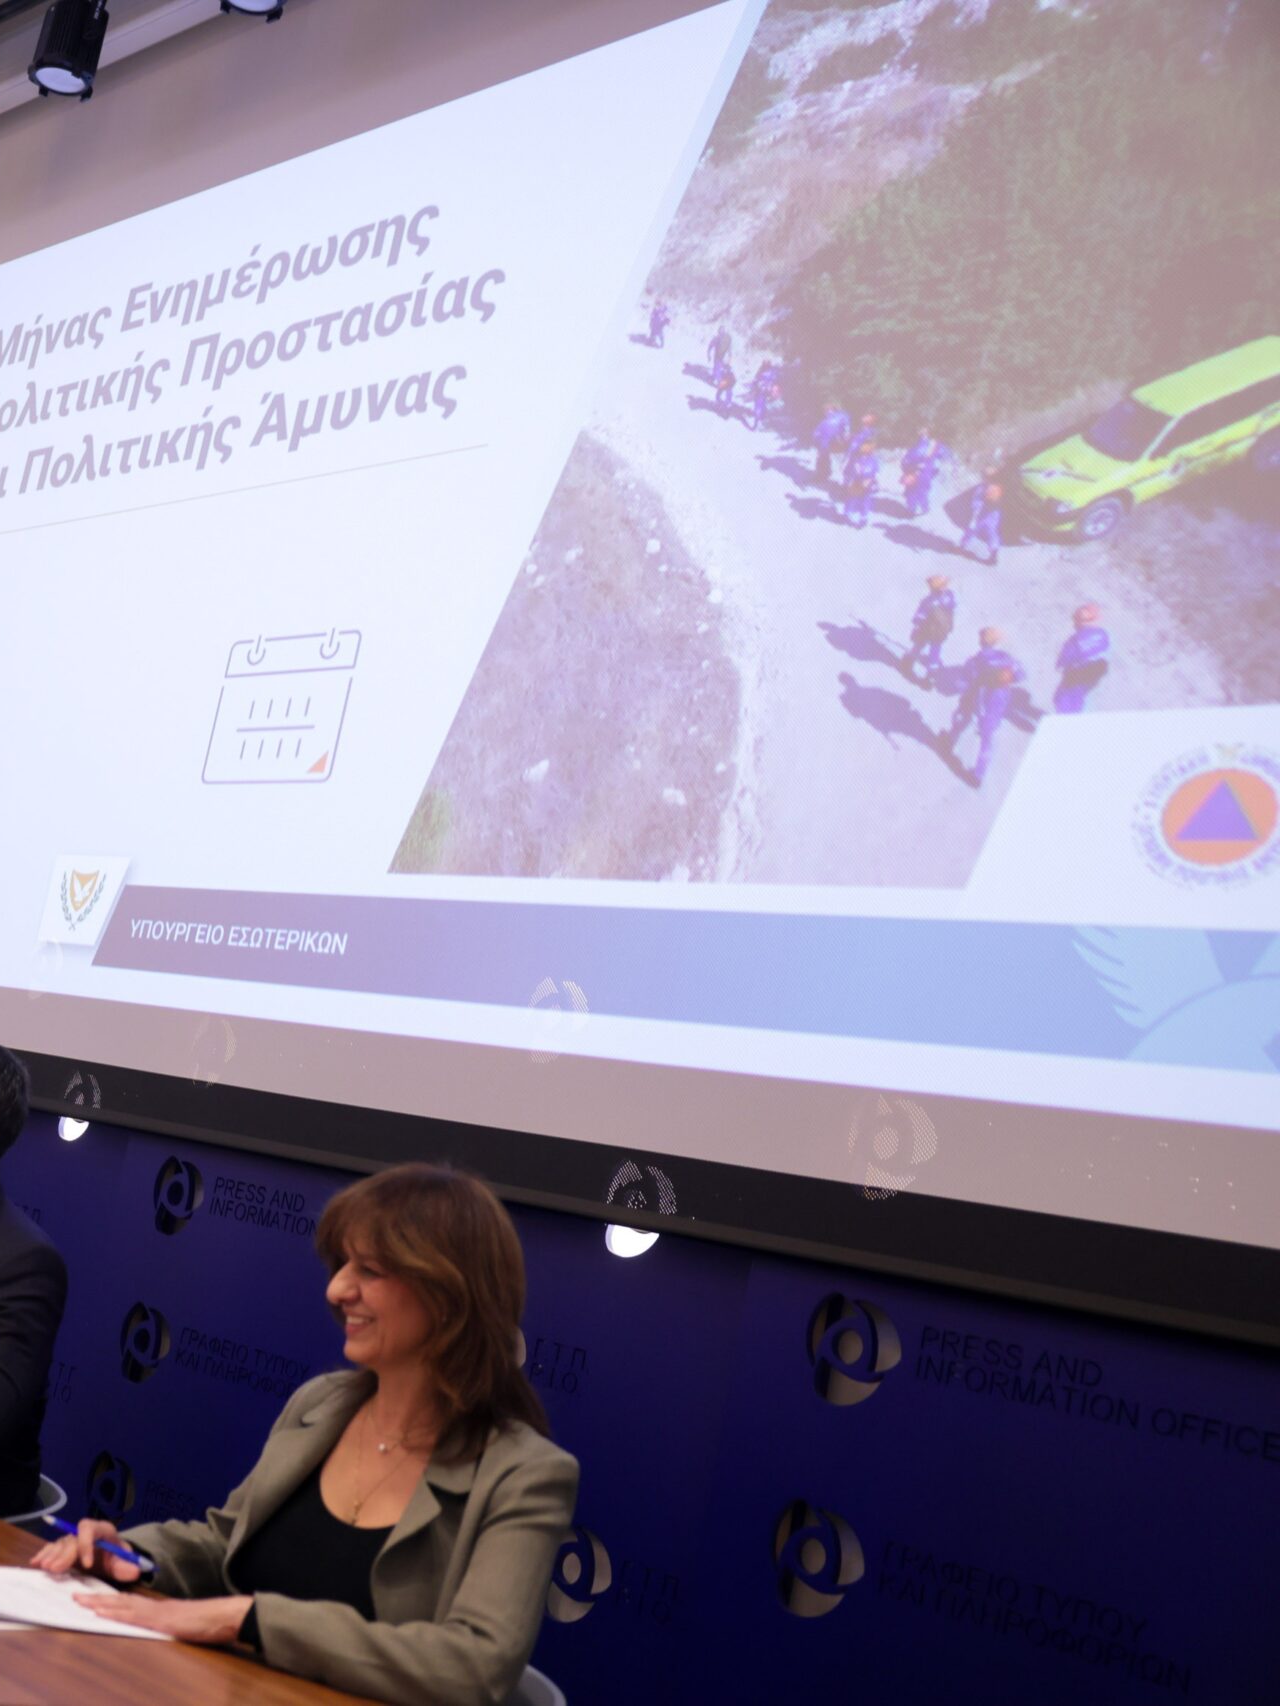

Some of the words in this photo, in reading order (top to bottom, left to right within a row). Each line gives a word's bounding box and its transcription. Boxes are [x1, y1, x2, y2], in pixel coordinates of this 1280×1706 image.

[120, 204, 440, 333] Ενημέρωσης
[179, 269, 506, 389] Προστασίας
[18, 405, 241, 494] Πολιτικής
[249, 364, 467, 451] Άμυνας
[131, 919, 224, 945] ΥΠΟΥΡΓΕΙΟ
[228, 926, 348, 955] ΕΣΩΤΕΡΙΚΩΝ
[214, 1176, 267, 1204] PRESS
[269, 1189, 305, 1212] AND
[180, 1327, 248, 1363] ΓΡΑΦΕΙΟ
[254, 1348, 310, 1380] ΤΥΠΟΥ
[920, 1325, 1024, 1371] PRESS
[1032, 1351, 1103, 1387] AND
[916, 1355, 1141, 1431] INFORMATION
[1151, 1407, 1280, 1463] OFFICE
